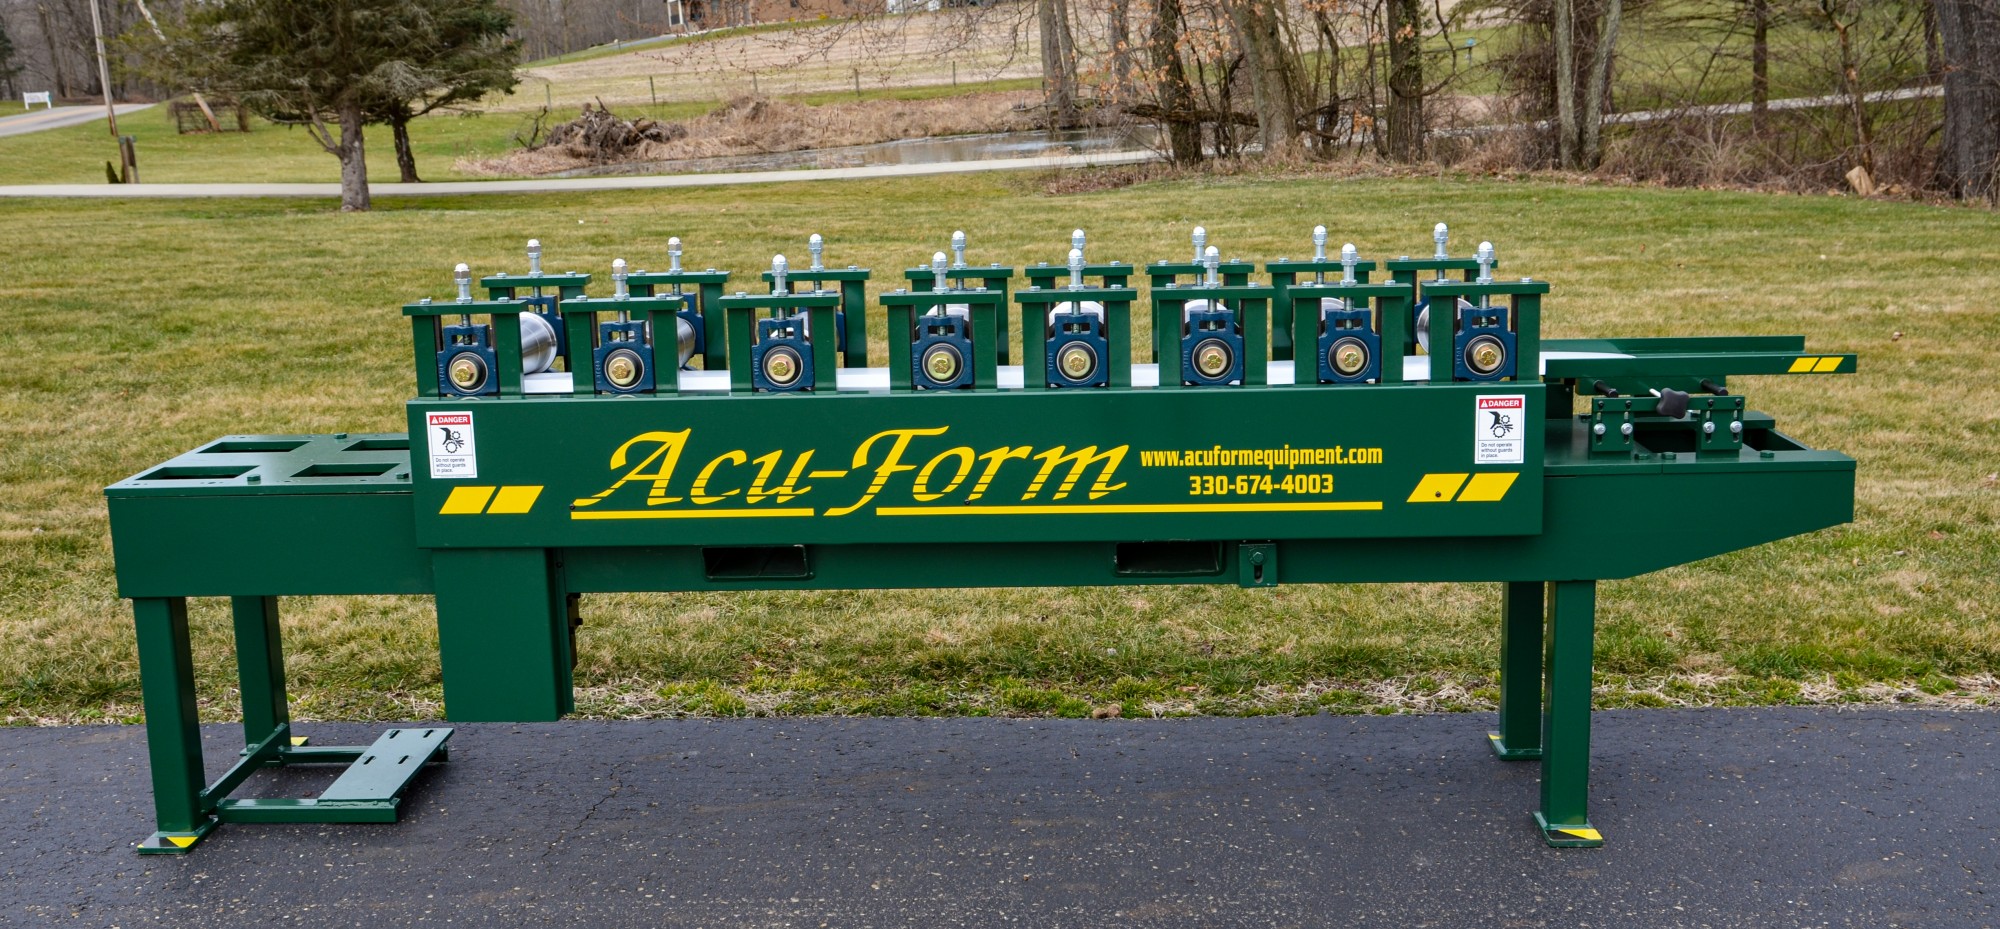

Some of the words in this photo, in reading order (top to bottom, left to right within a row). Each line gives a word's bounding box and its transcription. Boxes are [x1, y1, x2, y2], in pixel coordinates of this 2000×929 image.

[438, 416, 468, 424] DANGER
[1140, 444, 1383, 470] www.acuformequipment.com
[572, 425, 1130, 516] Acu-Form
[1189, 474, 1334, 496] 330-674-4003
